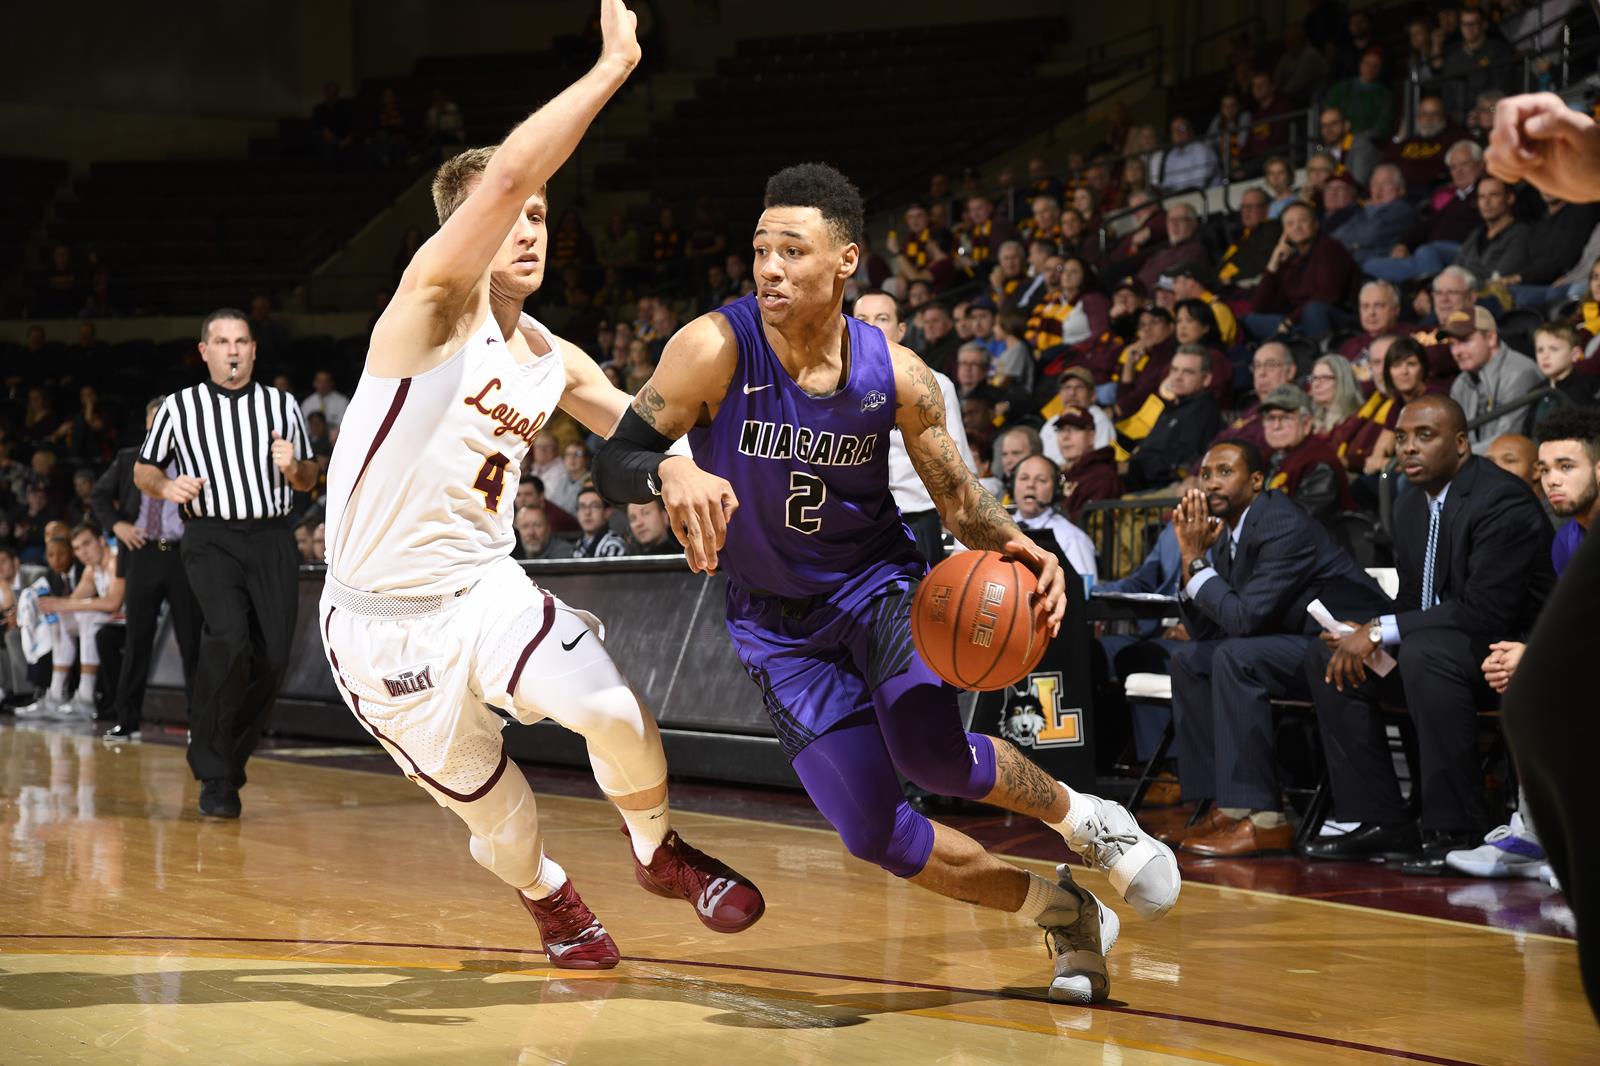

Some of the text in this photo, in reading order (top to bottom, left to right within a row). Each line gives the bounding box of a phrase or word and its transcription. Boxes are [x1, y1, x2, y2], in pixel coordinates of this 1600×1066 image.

[464, 378, 545, 447] Loyol
[738, 420, 877, 466] NIAGARA
[473, 452, 510, 514] 4
[785, 471, 827, 535] 2
[382, 665, 435, 697] VALLEY
